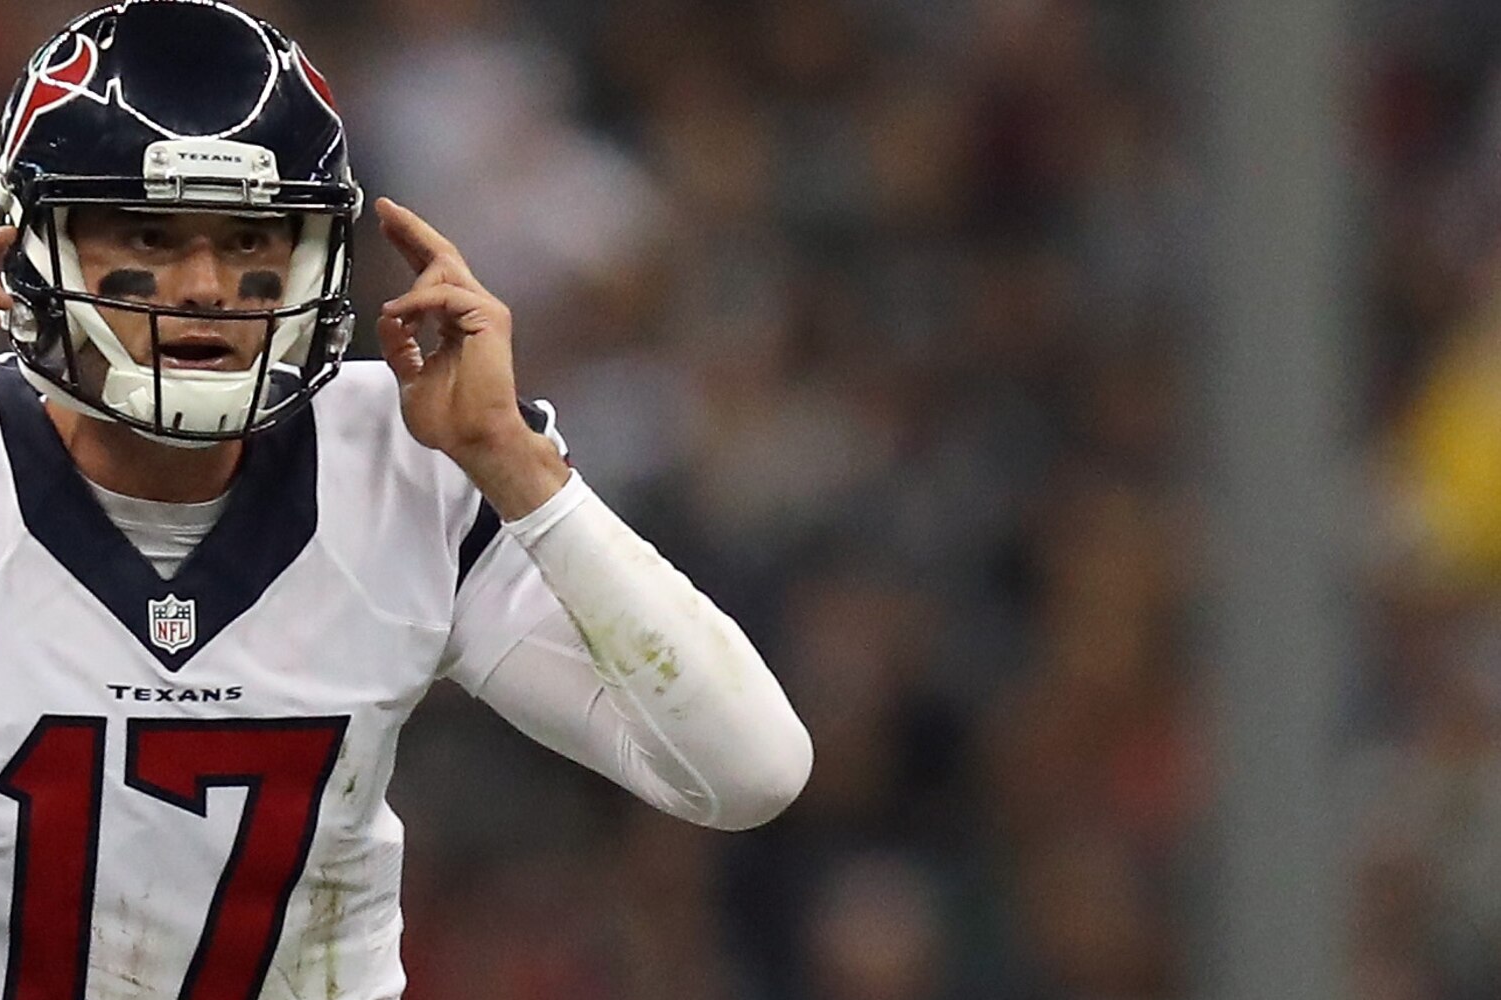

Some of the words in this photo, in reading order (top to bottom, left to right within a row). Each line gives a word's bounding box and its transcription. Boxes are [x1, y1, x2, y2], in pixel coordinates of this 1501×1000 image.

[178, 152, 242, 163] TEXANS
[157, 621, 190, 642] NFL
[106, 684, 243, 702] TEXANS
